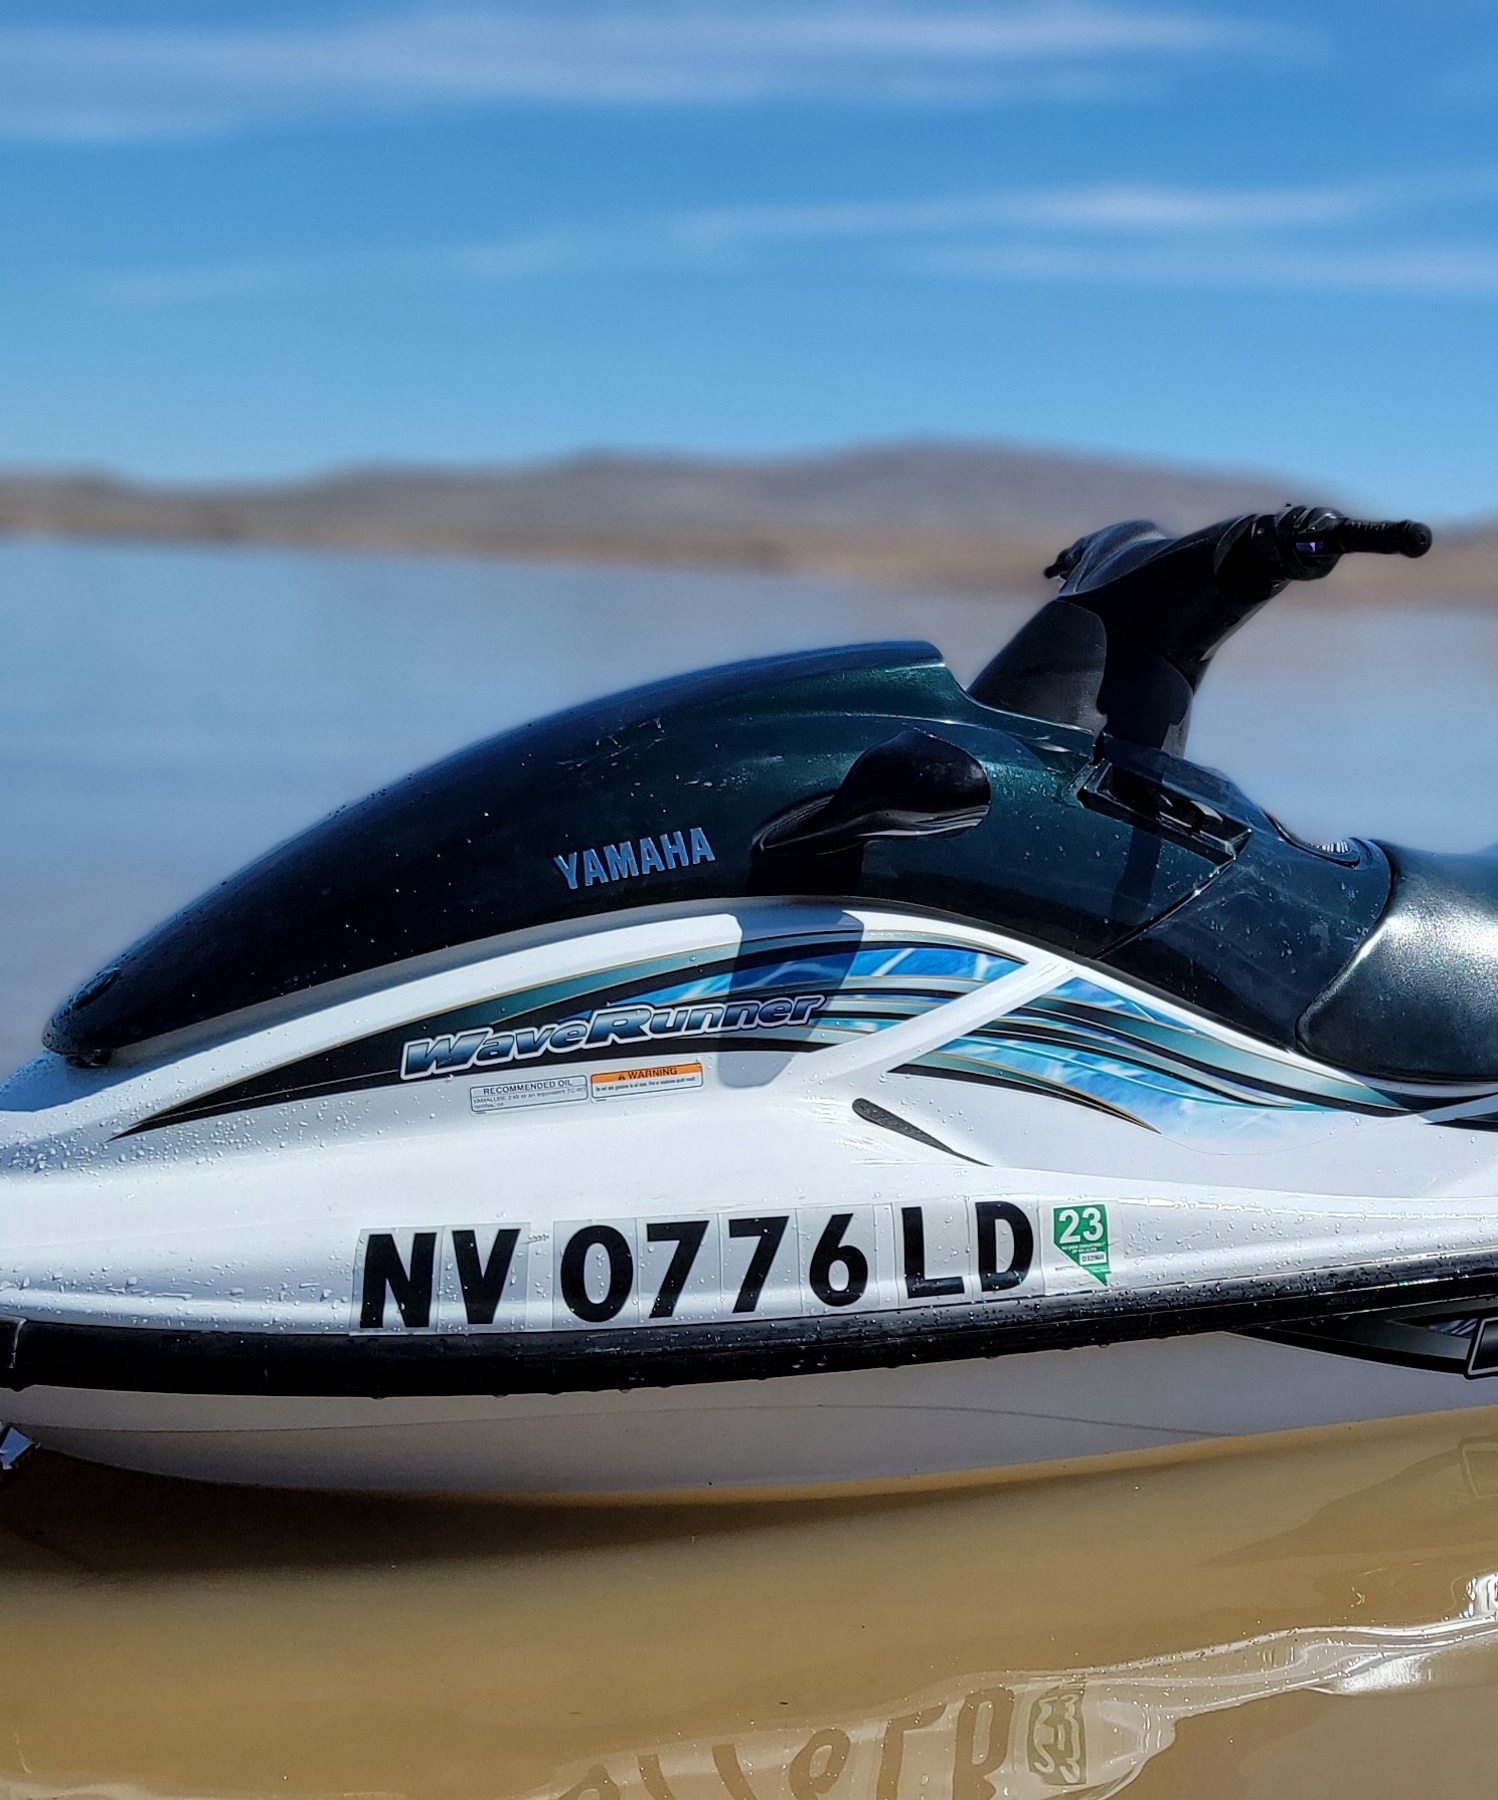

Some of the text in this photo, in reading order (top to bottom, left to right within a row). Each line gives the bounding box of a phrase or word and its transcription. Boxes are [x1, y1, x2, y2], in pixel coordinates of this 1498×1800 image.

[553, 826, 716, 890] YAMAHA
[400, 993, 826, 1081] WaveRunner
[483, 1079, 573, 1095] RECOMMENDED OIL
[628, 1067, 677, 1080] WARNING
[1058, 1207, 1104, 1244] 23
[360, 1201, 1034, 1329] NV 0776 LD
